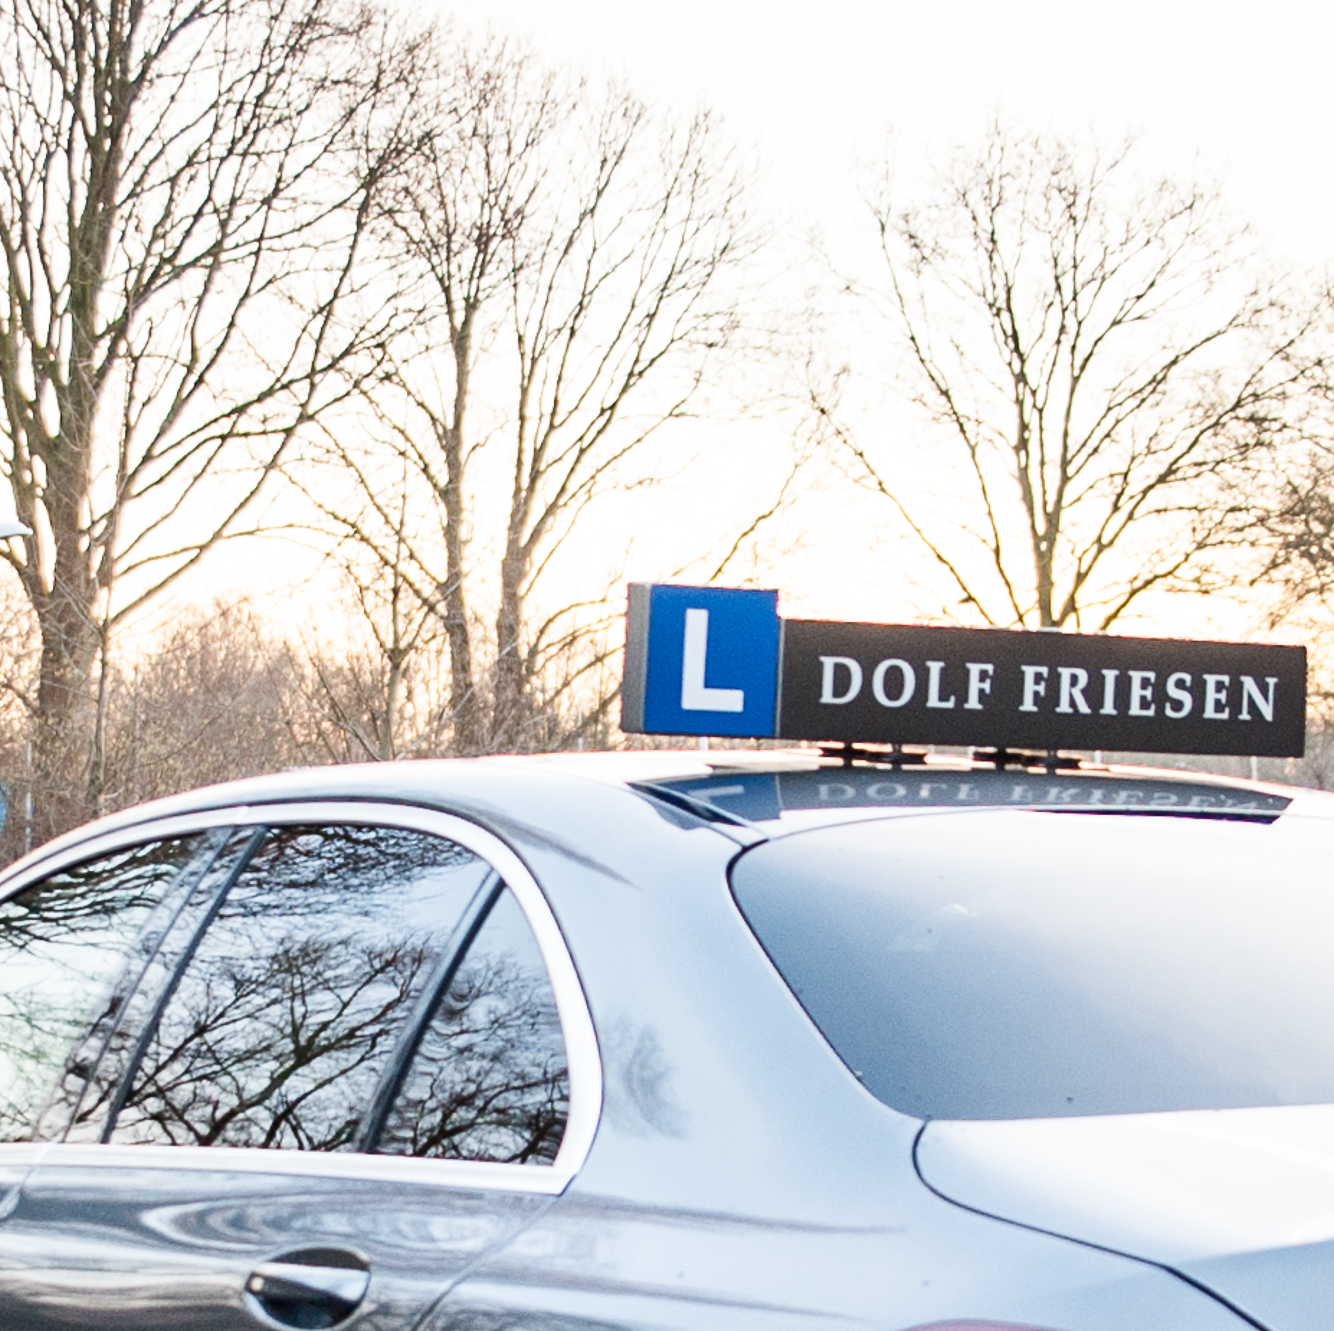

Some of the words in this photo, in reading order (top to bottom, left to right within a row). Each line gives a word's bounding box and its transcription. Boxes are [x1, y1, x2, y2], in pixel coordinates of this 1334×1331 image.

[680, 607, 745, 713] L
[818, 655, 995, 710] DOLF
[1018, 664, 1279, 722] FRIESEN
